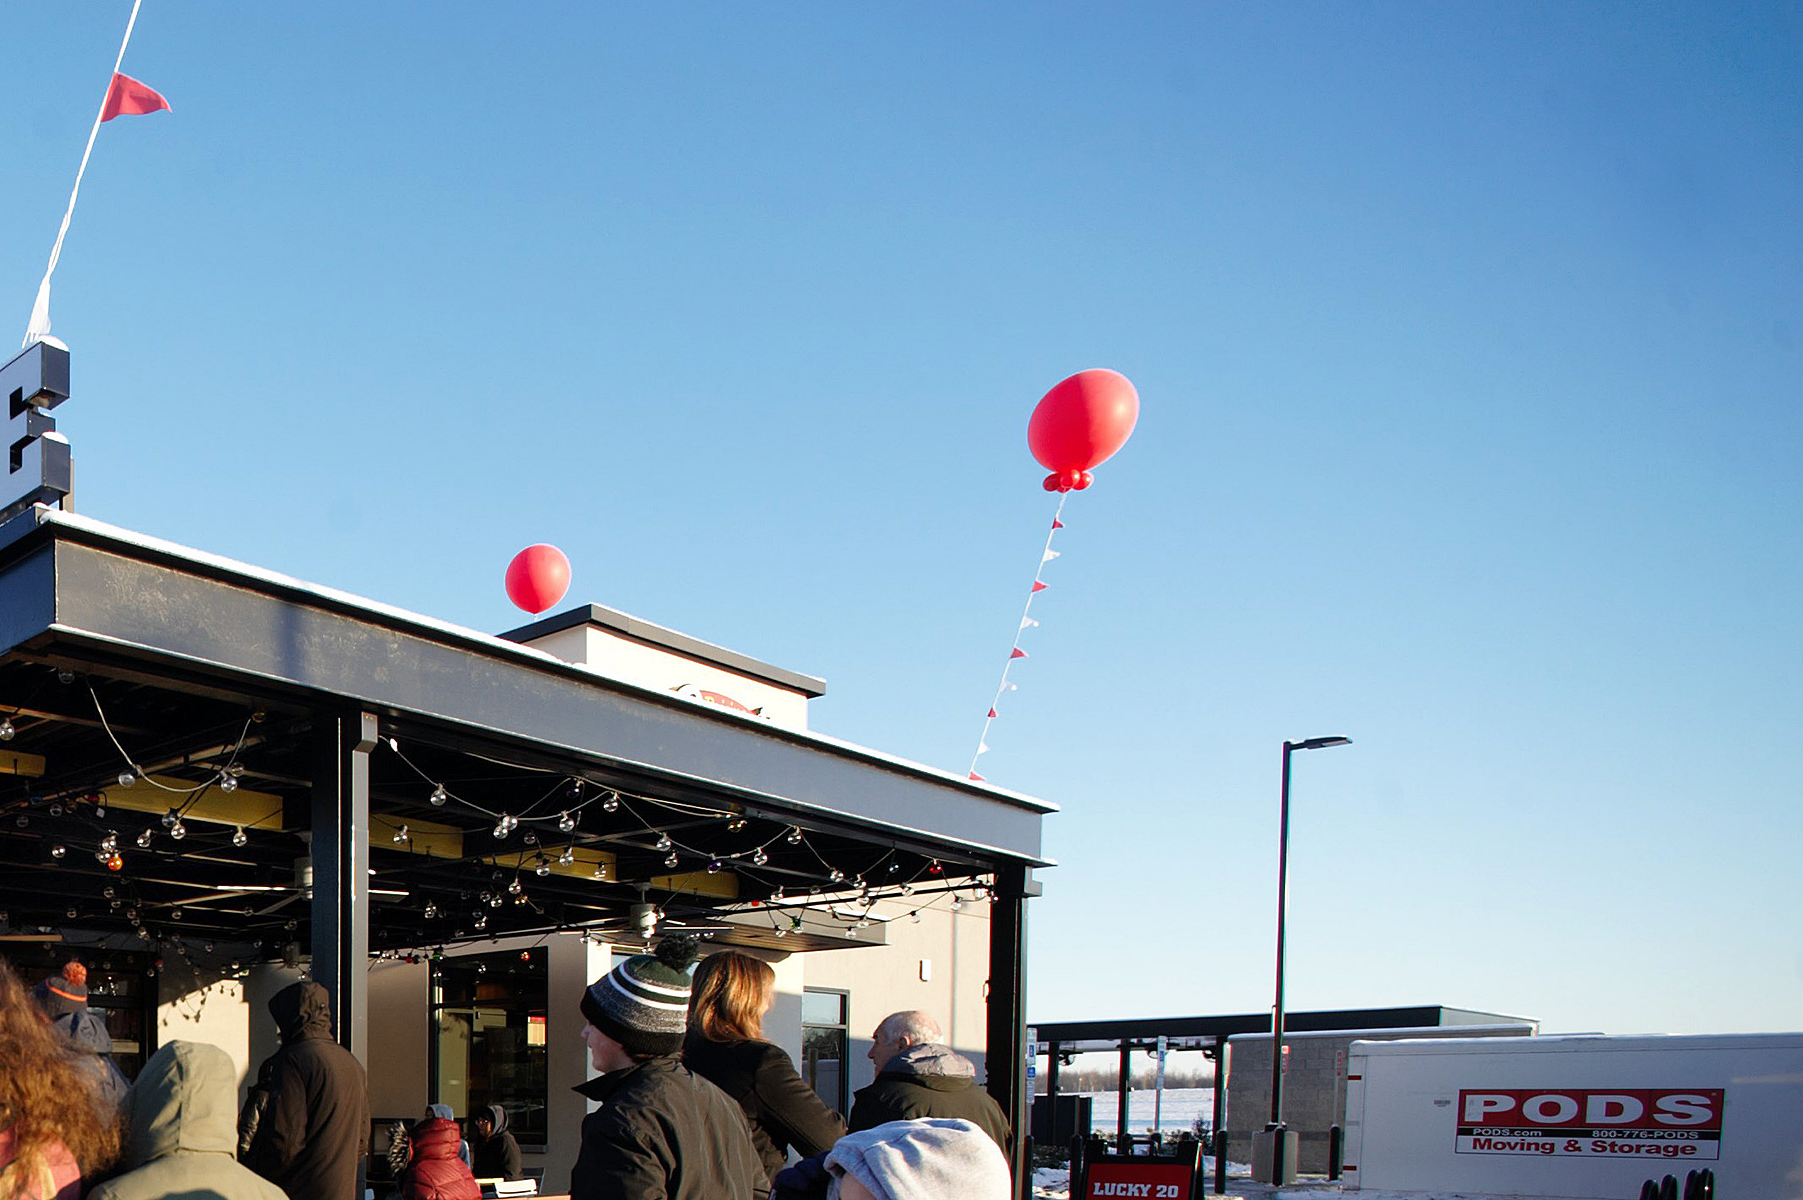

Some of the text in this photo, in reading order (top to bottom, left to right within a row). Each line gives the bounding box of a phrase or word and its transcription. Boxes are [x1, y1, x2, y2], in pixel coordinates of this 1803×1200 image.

[1464, 1094, 1713, 1125] PODS
[1472, 1128, 1699, 1139] PODS.com 800-776-PODS
[1472, 1138, 1697, 1158] Moving & Storage
[1093, 1182, 1179, 1198] LUCKY 20
